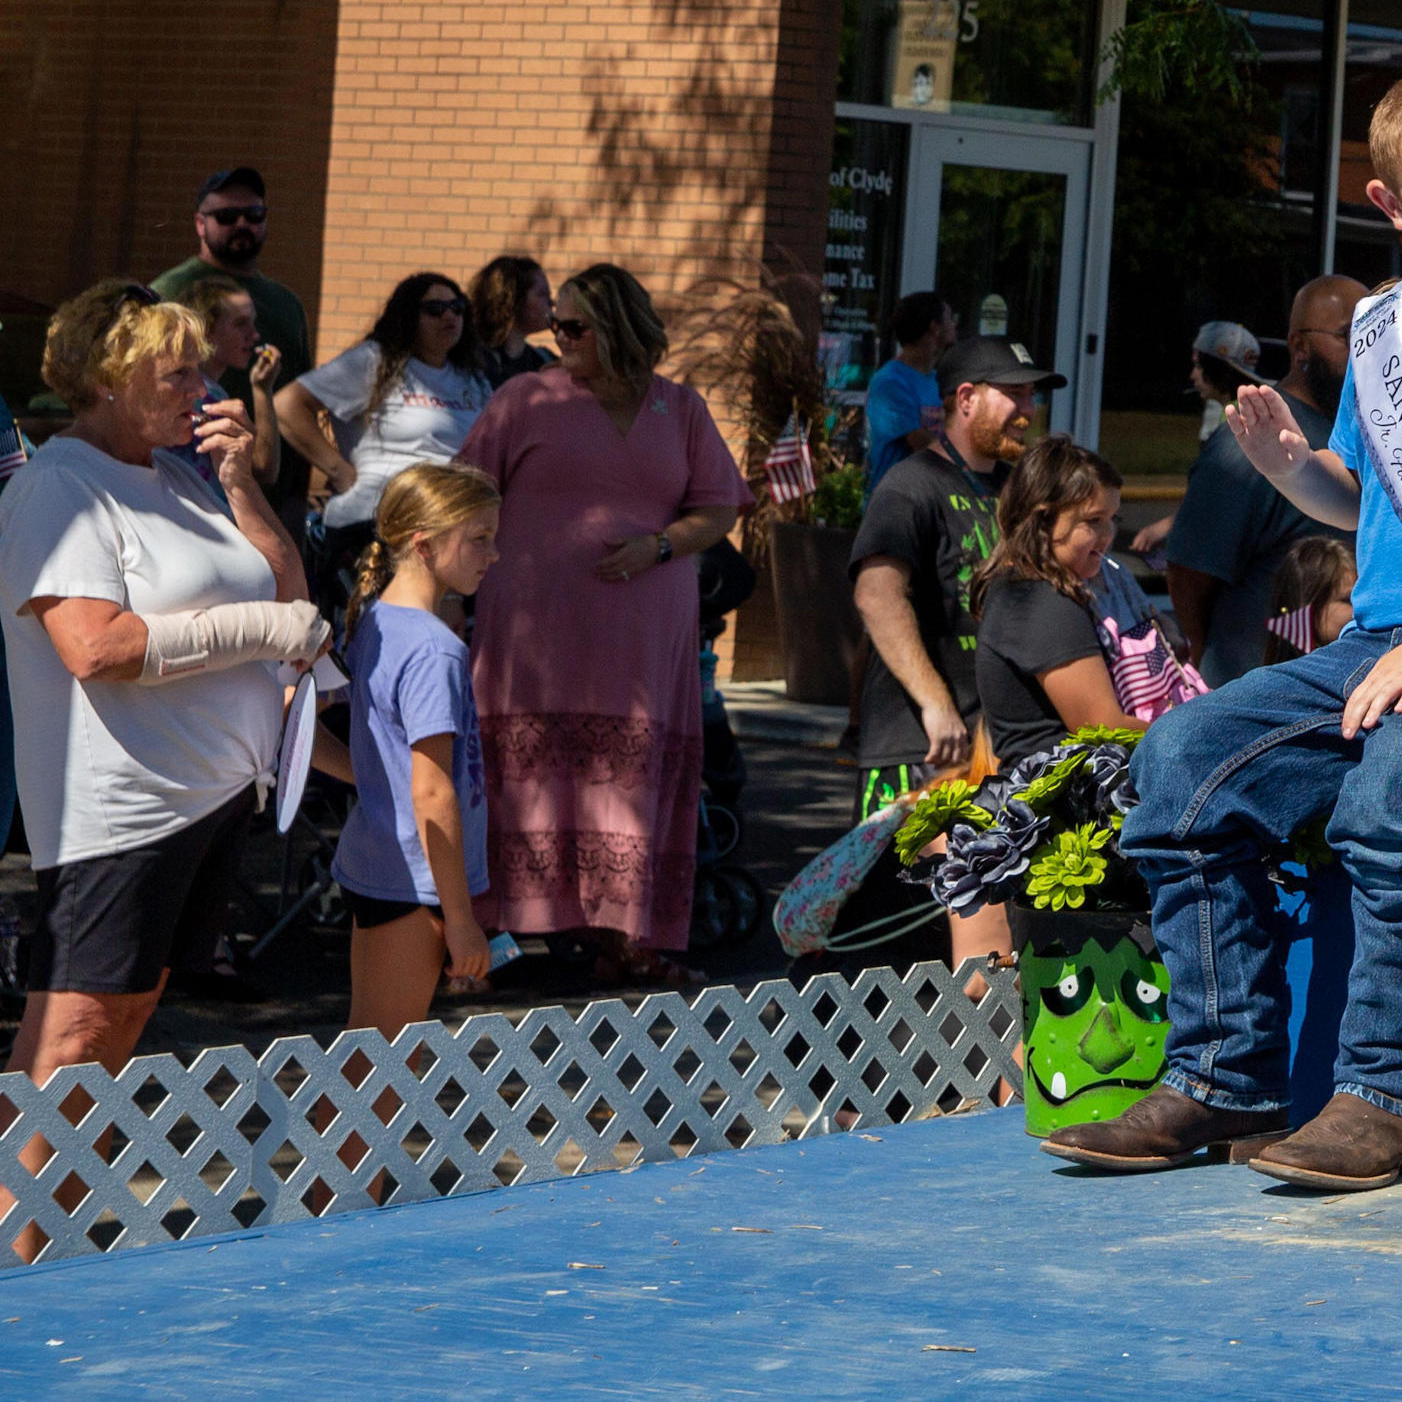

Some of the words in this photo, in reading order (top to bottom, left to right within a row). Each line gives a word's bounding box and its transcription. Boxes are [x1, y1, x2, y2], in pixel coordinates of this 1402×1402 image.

[828, 208, 868, 231] ilities
[825, 244, 866, 260] nance
[851, 267, 875, 289] Tax
[1354, 310, 1397, 358] 2024
[1369, 408, 1397, 448] Jr.
